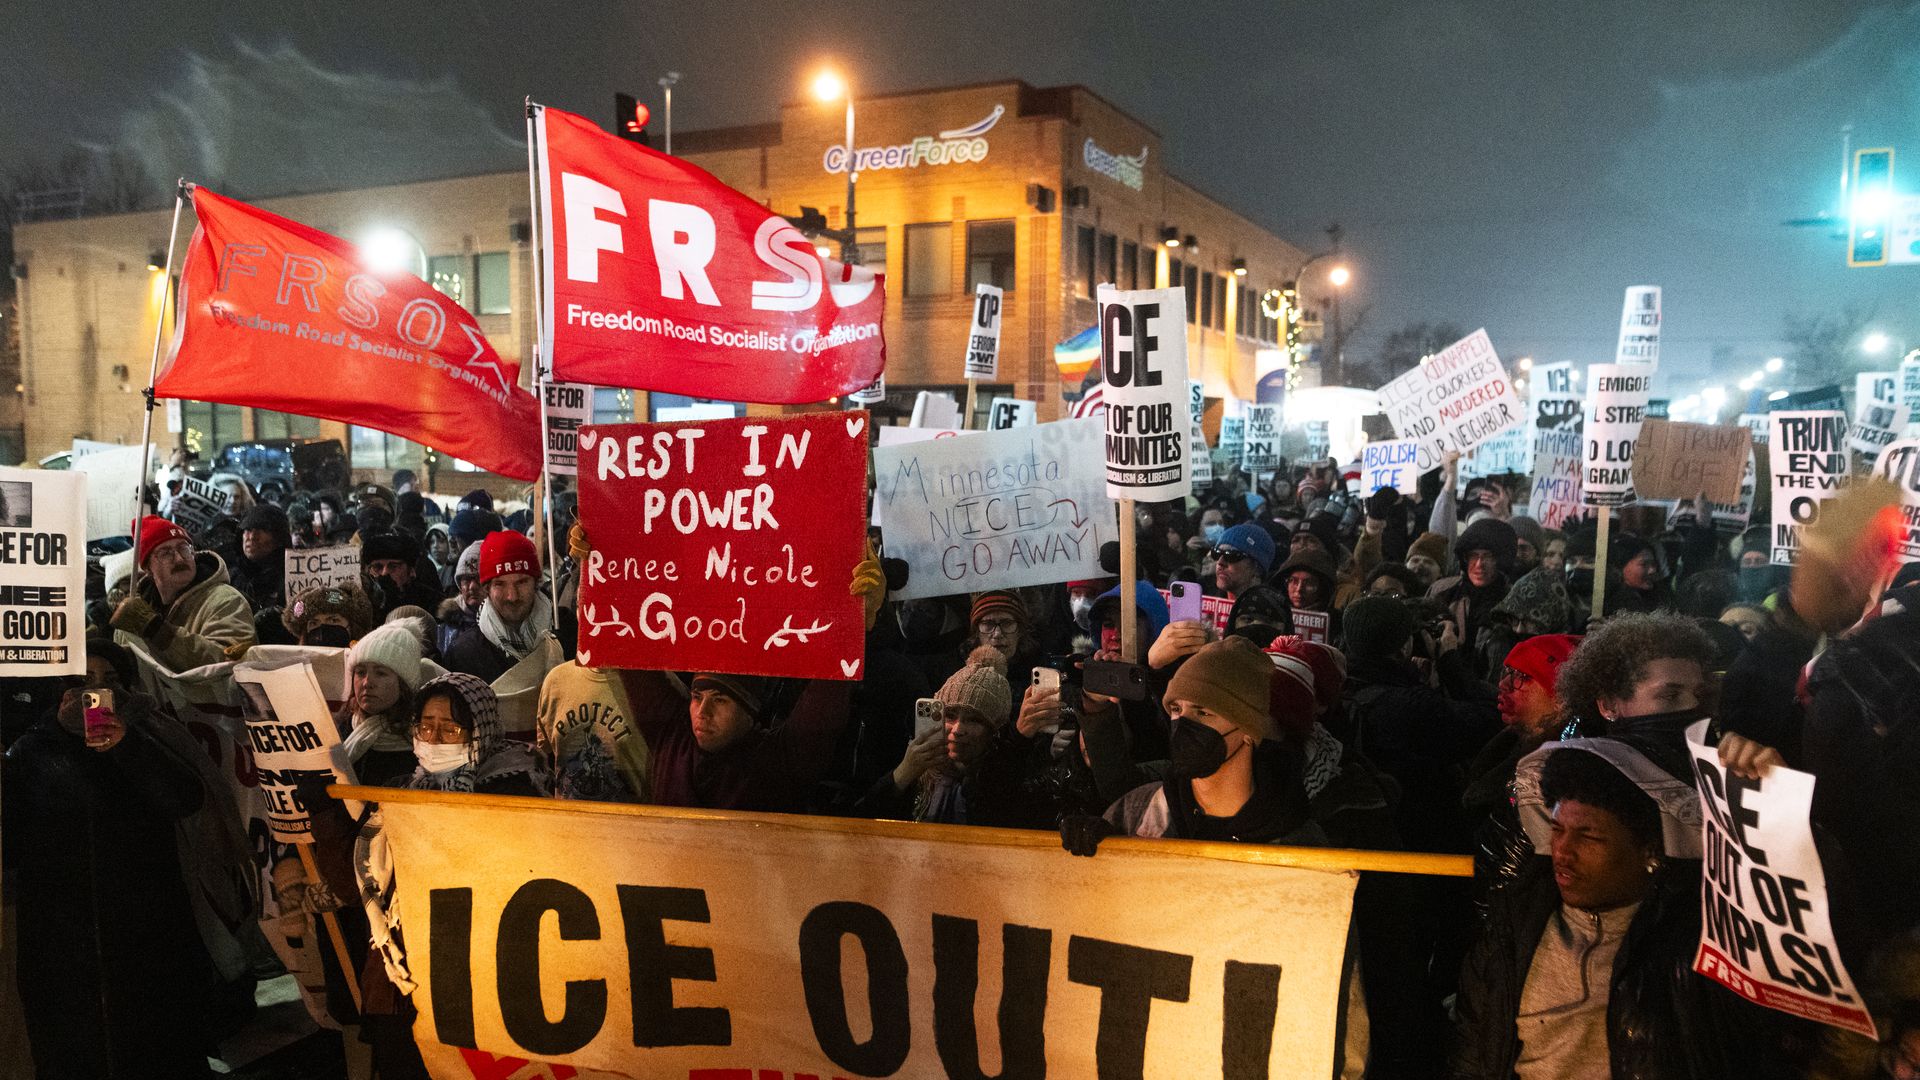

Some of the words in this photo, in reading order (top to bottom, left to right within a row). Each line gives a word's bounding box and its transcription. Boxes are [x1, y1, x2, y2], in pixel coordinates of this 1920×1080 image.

[825, 138, 988, 171] CareerForce
[218, 242, 446, 350] FRSO
[296, 322, 345, 347] Road
[348, 334, 423, 365] Socialist
[567, 304, 662, 335] Freedom
[664, 319, 706, 342] Road
[710, 327, 787, 351] Socialist
[1099, 303, 1163, 388] CE
[1384, 372, 1423, 407] ICE
[1421, 334, 1489, 384] KIDNAPPED
[1399, 397, 1423, 424] MY
[1427, 356, 1497, 406] COWORKERS
[557, 386, 584, 409] FOR
[1404, 416, 1436, 440] AND
[1439, 379, 1505, 427] MURDERED
[1605, 405, 1644, 424] STRE
[1113, 405, 1134, 434] OF
[1136, 403, 1172, 434] OUR
[1417, 439, 1445, 470] OUR
[1449, 403, 1515, 452] NEIGHBOR
[598, 428, 705, 481] REST
[741, 425, 811, 477] IN
[1363, 443, 1418, 469] ABOLISH
[1540, 431, 1583, 458] IMMIG
[1788, 453, 1846, 474] END
[888, 438, 1063, 506] Minnesota
[1137, 473, 1147, 484] &
[1148, 468, 1180, 484] LIBERATION
[1370, 469, 1403, 491] ICE
[1533, 476, 1583, 503] AMERIC
[1775, 474, 1815, 489] THE
[185, 478, 228, 508] KILLER
[643, 483, 780, 534] POWER
[929, 493, 1037, 542] NICE
[1537, 500, 1588, 529] GREA
[19, 532, 68, 566] FOR
[288, 553, 332, 575] ICE
[333, 555, 361, 566] WILL
[495, 560, 529, 574] FRSO
[588, 549, 679, 588] Renee
[704, 541, 819, 588] Nicole
[941, 541, 993, 581] GO
[1006, 523, 1101, 572] AWAY!
[3, 610, 67, 641] GOOD
[639, 592, 748, 645] Good
[19, 649, 65, 661] LIBERATION
[278, 721, 323, 752] FOR
[555, 702, 632, 742] PROTECT
[1706, 819, 1745, 912] OUT
[1750, 866, 1814, 937] OF
[1704, 876, 1857, 1005] MPLS!
[428, 877, 732, 1057] ICE
[1701, 951, 1757, 1000] FRSO
